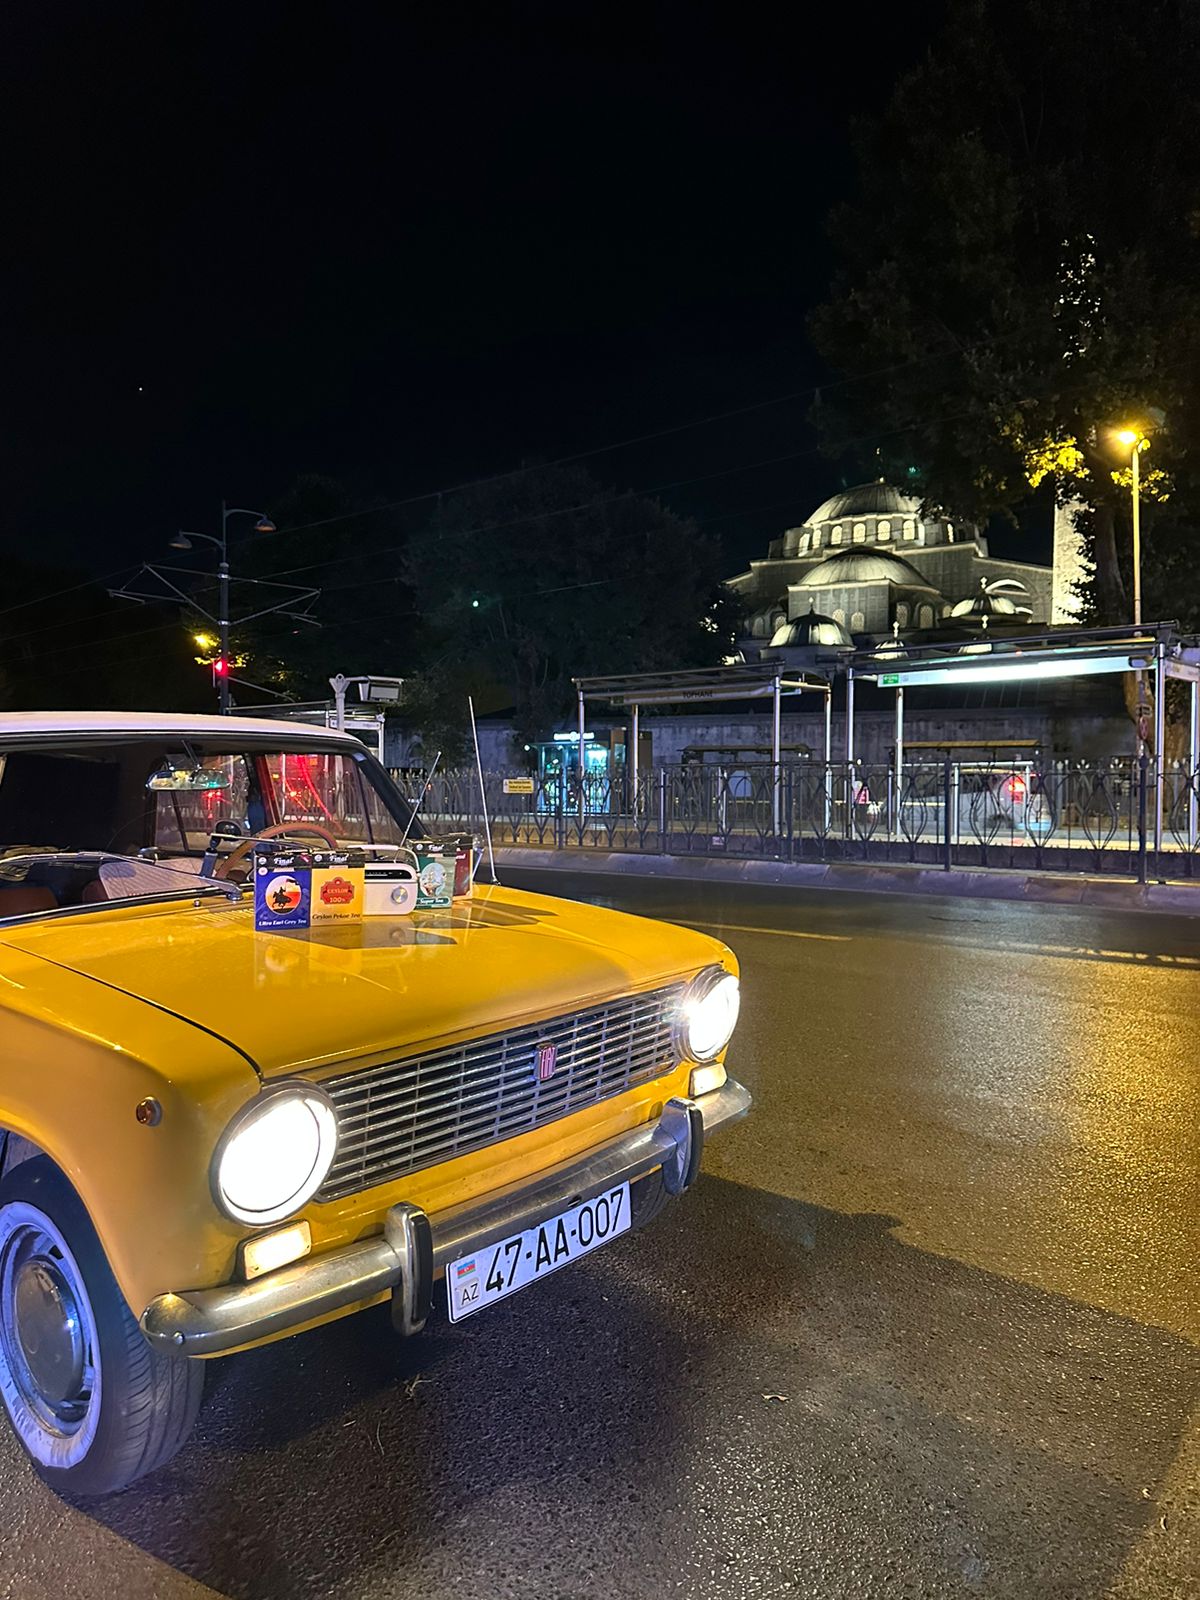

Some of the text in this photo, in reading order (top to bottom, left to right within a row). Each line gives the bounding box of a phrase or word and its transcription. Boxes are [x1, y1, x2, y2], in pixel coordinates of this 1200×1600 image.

[273, 856, 294, 866] Final
[329, 853, 349, 863] Final
[485, 1187, 624, 1293] 47-AA-007
[461, 1282, 479, 1306] AZ
